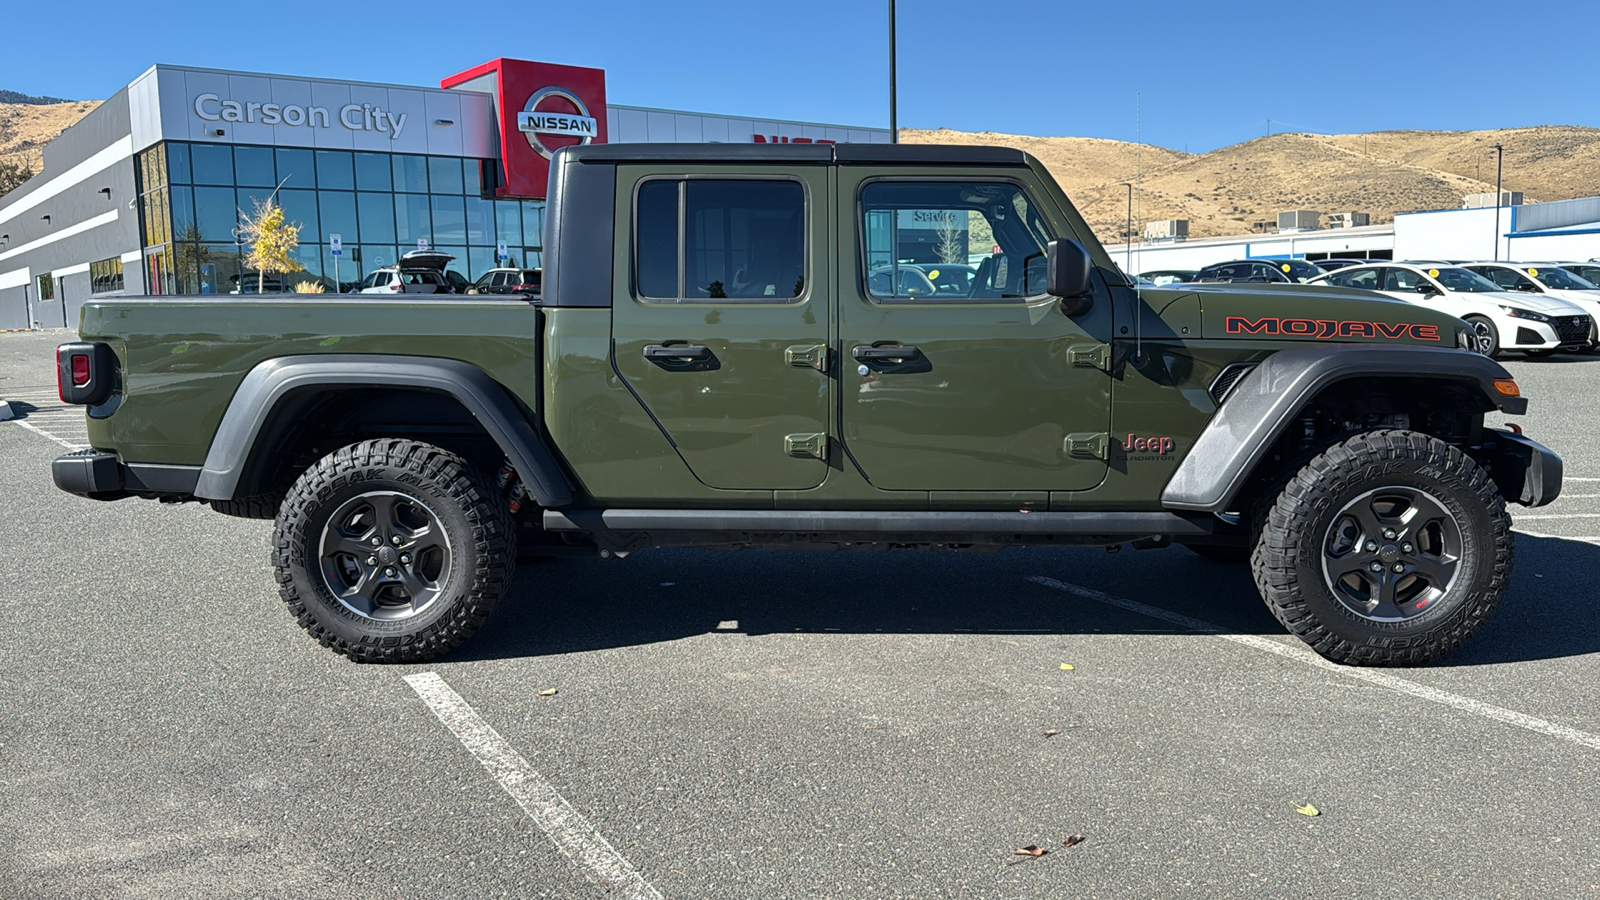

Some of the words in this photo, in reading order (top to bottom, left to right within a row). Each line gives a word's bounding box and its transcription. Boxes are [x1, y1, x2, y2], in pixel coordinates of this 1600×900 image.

[194, 93, 330, 128] Carson
[340, 103, 408, 140] City
[527, 116, 592, 133] NISSAN
[914, 210, 958, 222] Service
[1226, 316, 1441, 341] MOJAVE
[1122, 433, 1175, 455] Jeep
